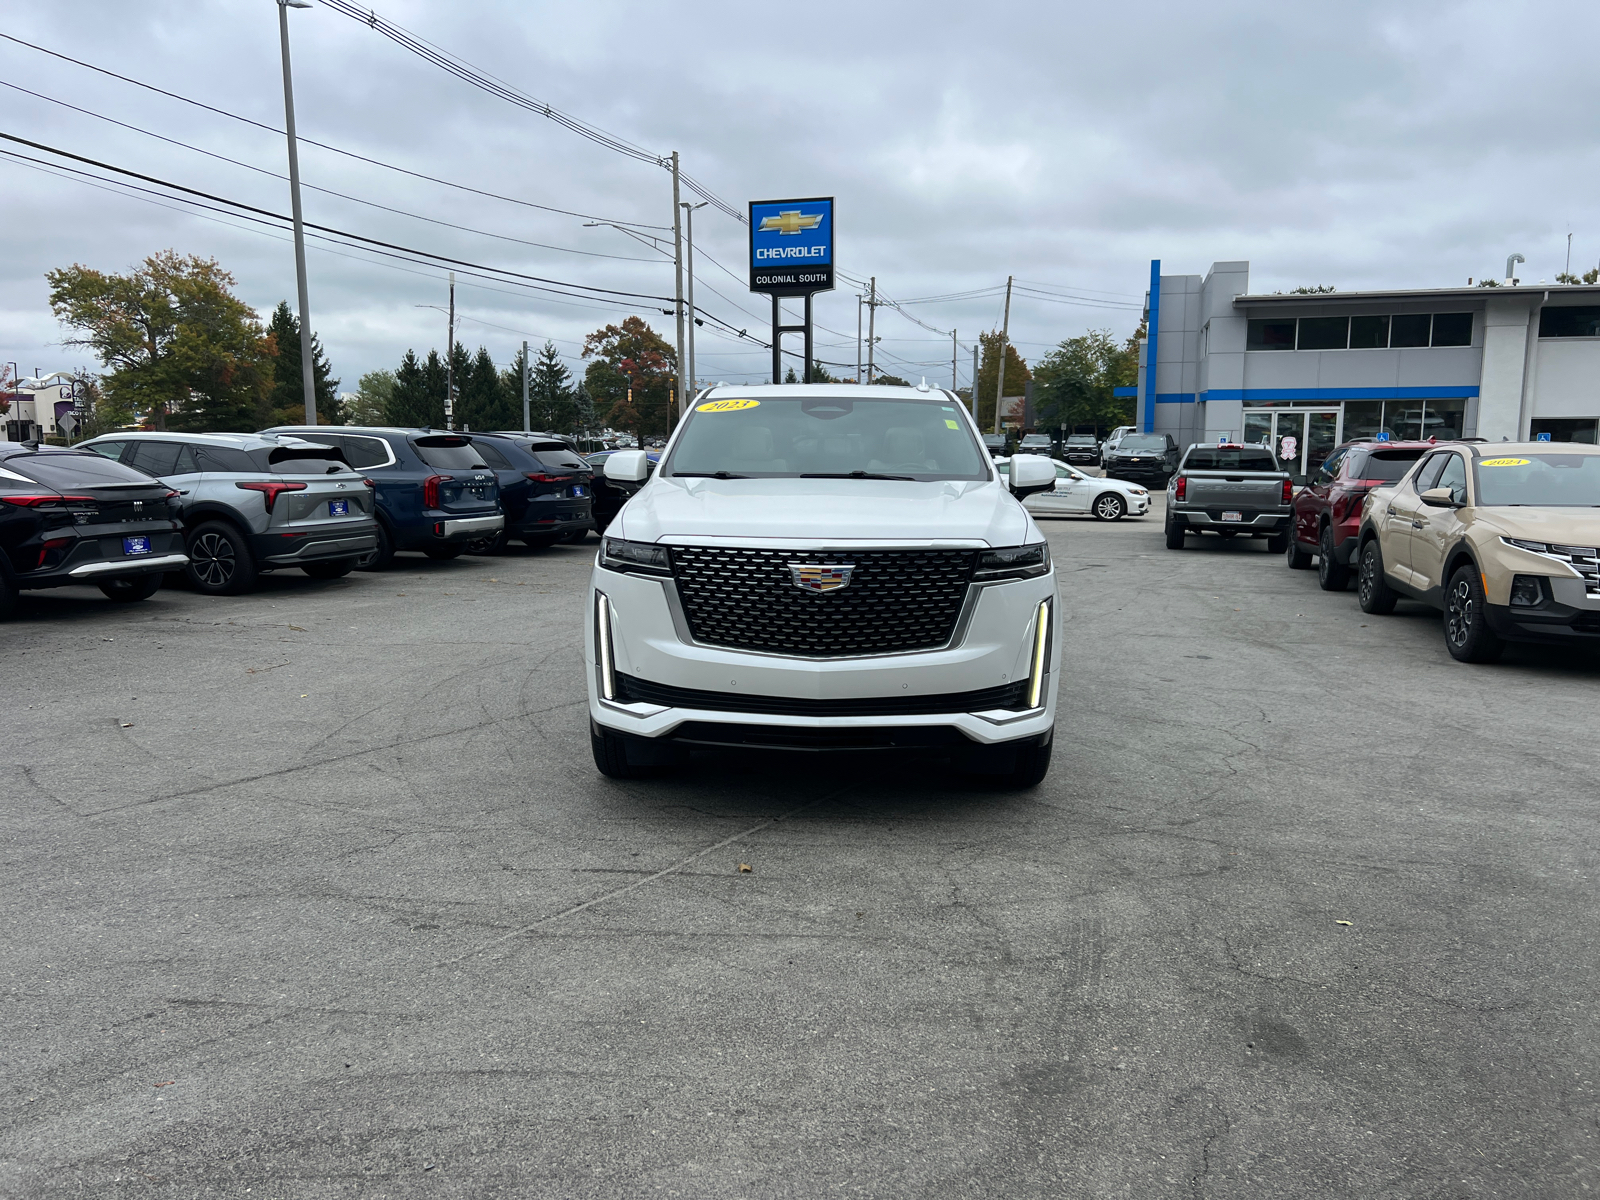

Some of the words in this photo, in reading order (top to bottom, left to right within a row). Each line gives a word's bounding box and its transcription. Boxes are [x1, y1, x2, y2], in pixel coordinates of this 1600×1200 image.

[756, 245, 826, 259] CHEVROLET
[756, 275, 796, 284] COLONIAL
[798, 273, 827, 282] SOUTH
[704, 400, 751, 411] 2023
